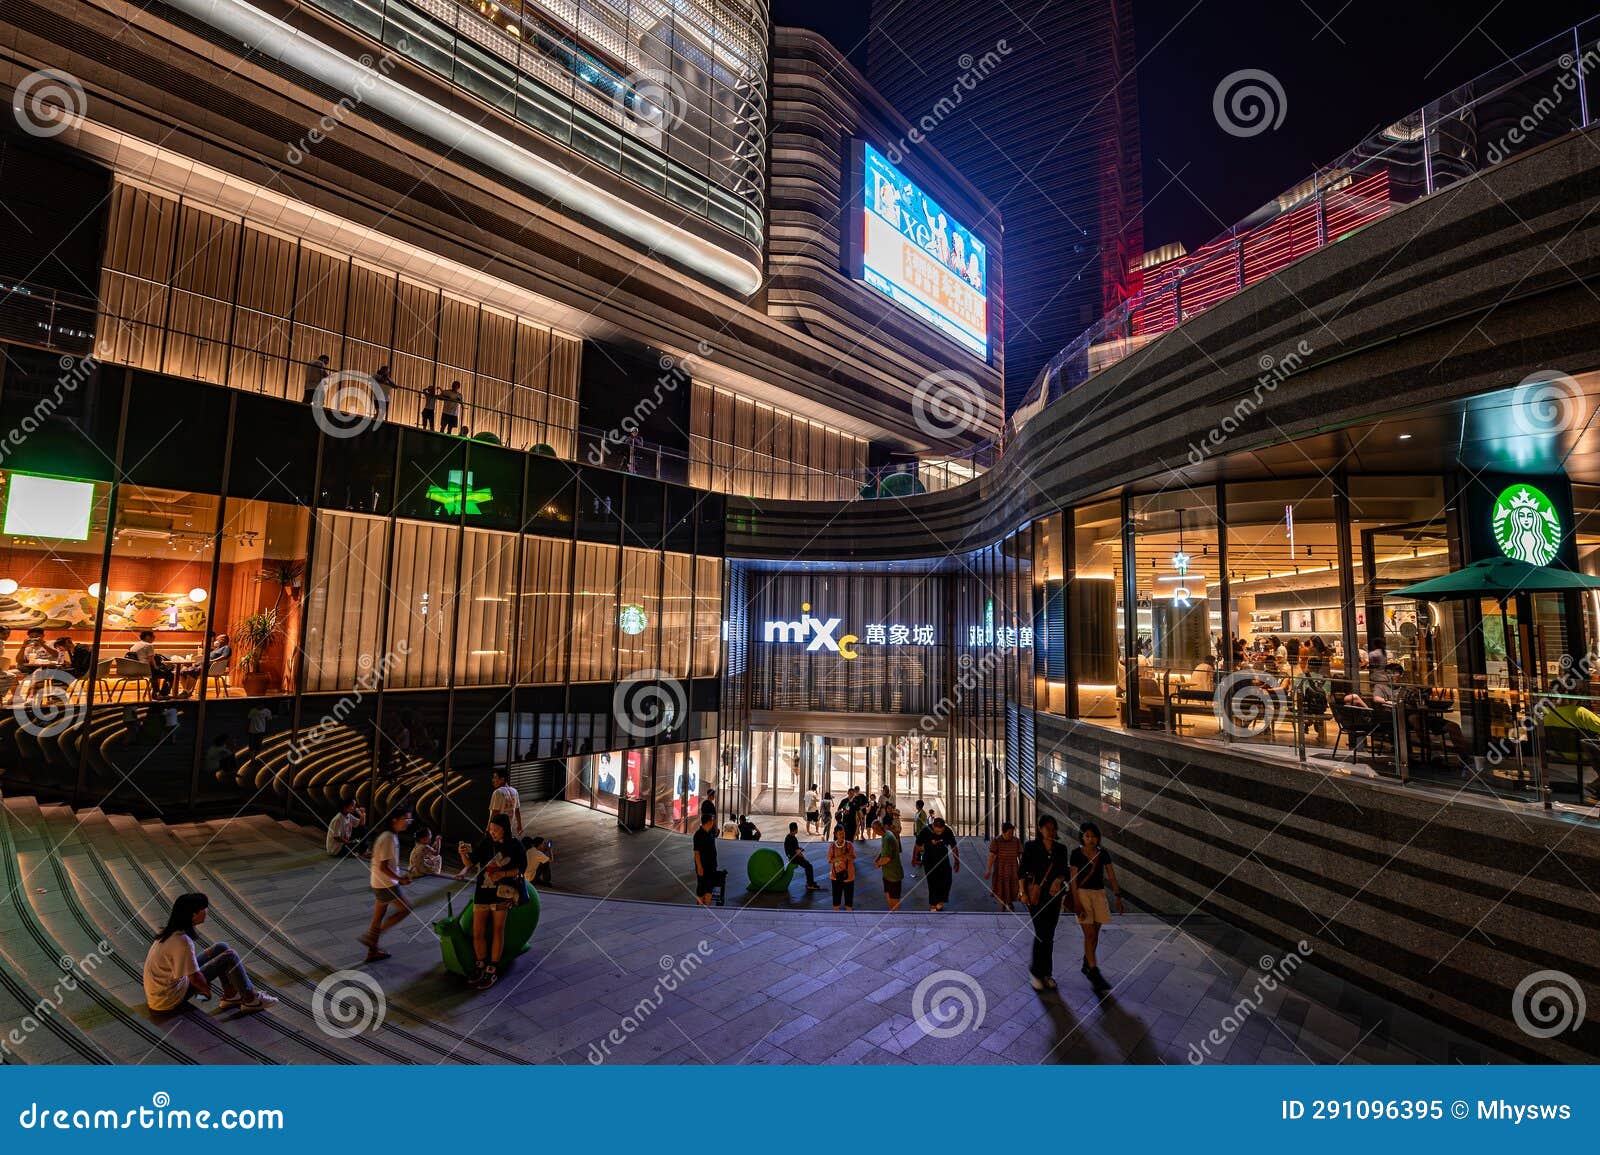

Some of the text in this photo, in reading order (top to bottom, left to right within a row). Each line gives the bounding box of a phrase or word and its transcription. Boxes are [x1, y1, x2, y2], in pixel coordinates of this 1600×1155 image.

[1172, 586, 1192, 608] R
[865, 623, 935, 646] 萬象城
